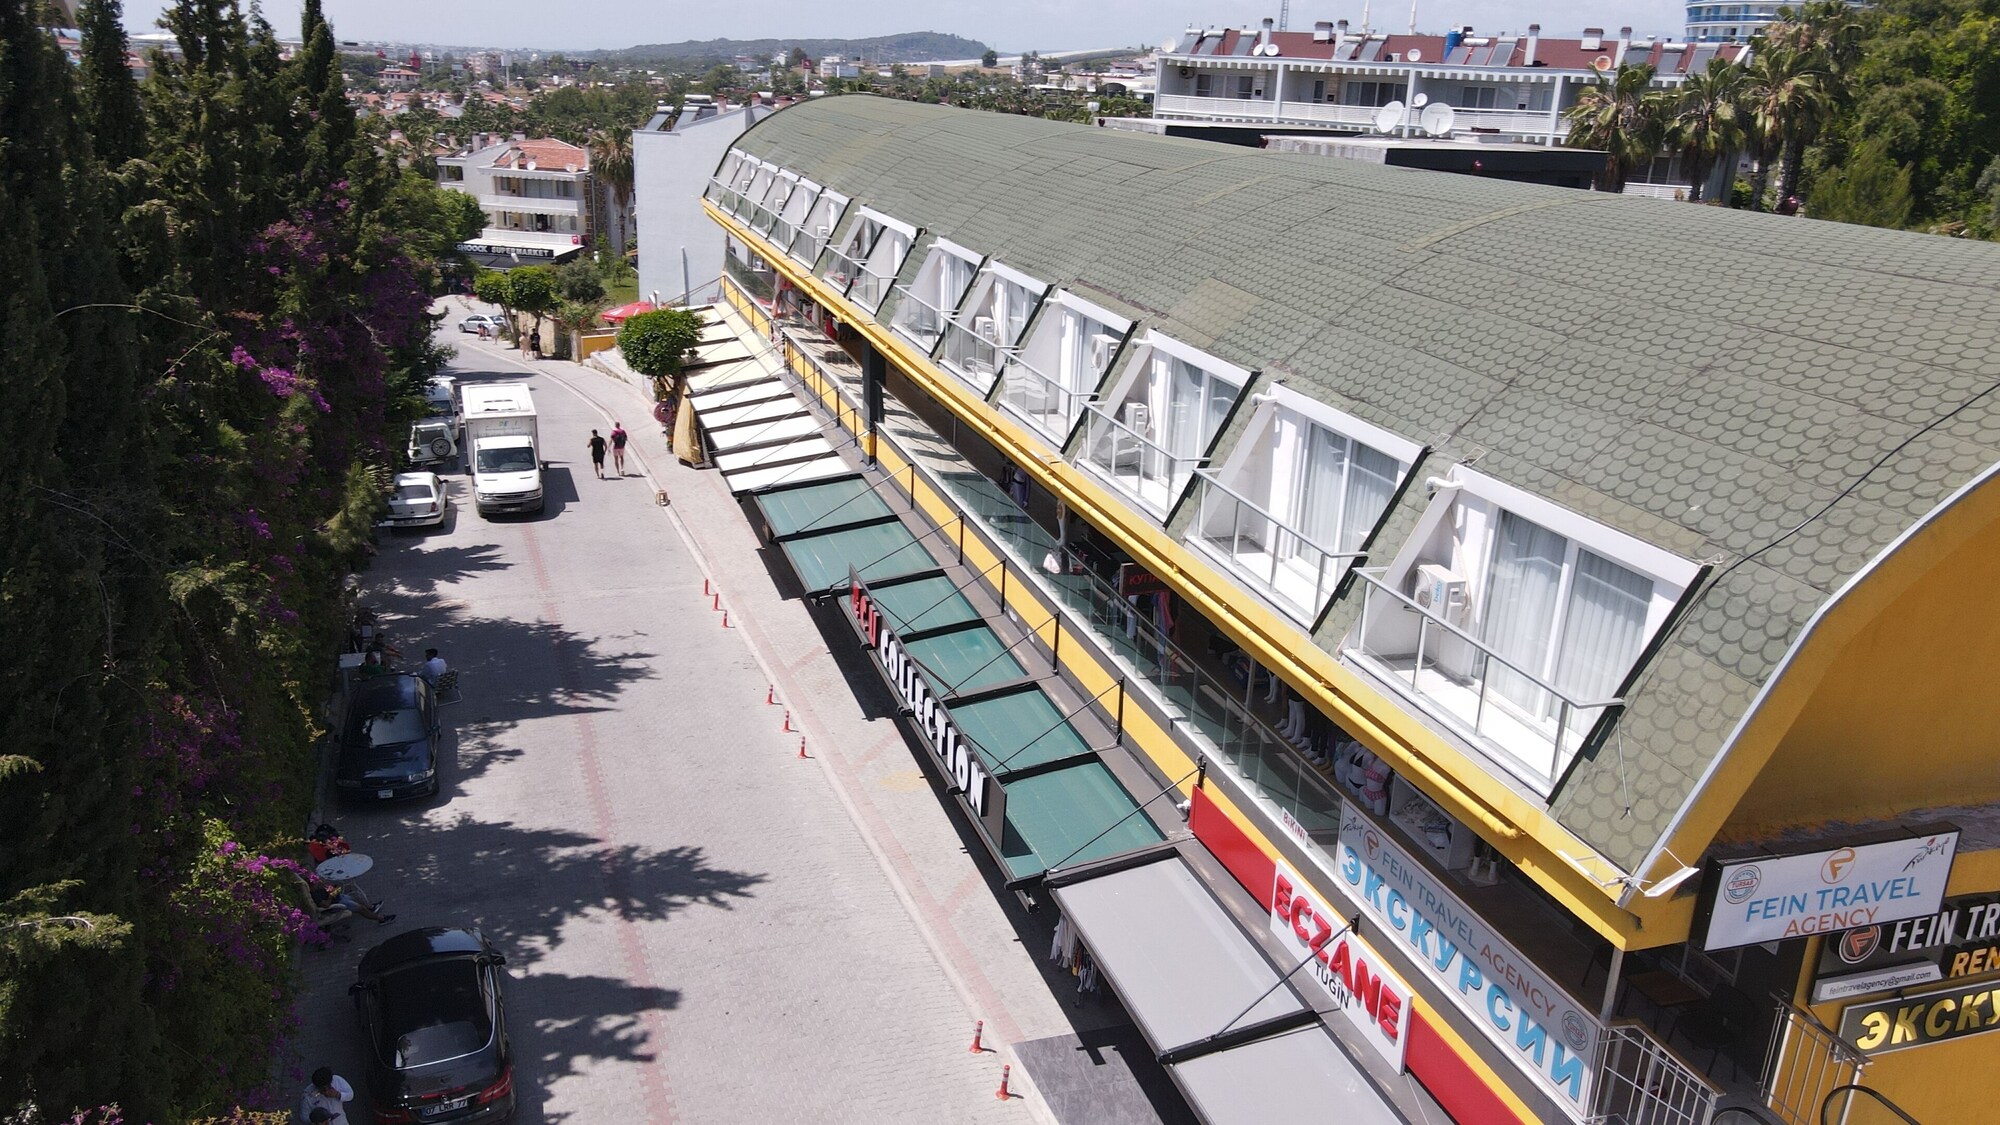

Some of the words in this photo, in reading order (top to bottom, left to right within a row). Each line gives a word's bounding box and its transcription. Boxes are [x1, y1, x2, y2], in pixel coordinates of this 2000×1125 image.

[491, 246, 549, 256] SUPERMARKET
[880, 629, 988, 818] COLLECTION
[1745, 892, 1808, 922] FEIN
[1816, 876, 1920, 911] TRAVEL
[1783, 906, 1880, 937] AGENCY
[1382, 851, 1414, 890] FEIN
[1417, 880, 1477, 950] TRAVEL
[1480, 943, 1556, 1018] AGENCY
[1889, 909, 1959, 954] FEIN
[1965, 902, 2000, 941] TR
[1274, 873, 1402, 1041] ECZANE
[1342, 845, 1584, 1101] ЭКСКУРСИИ
[1829, 971, 1931, 995] feintravelagency@gmail.com
